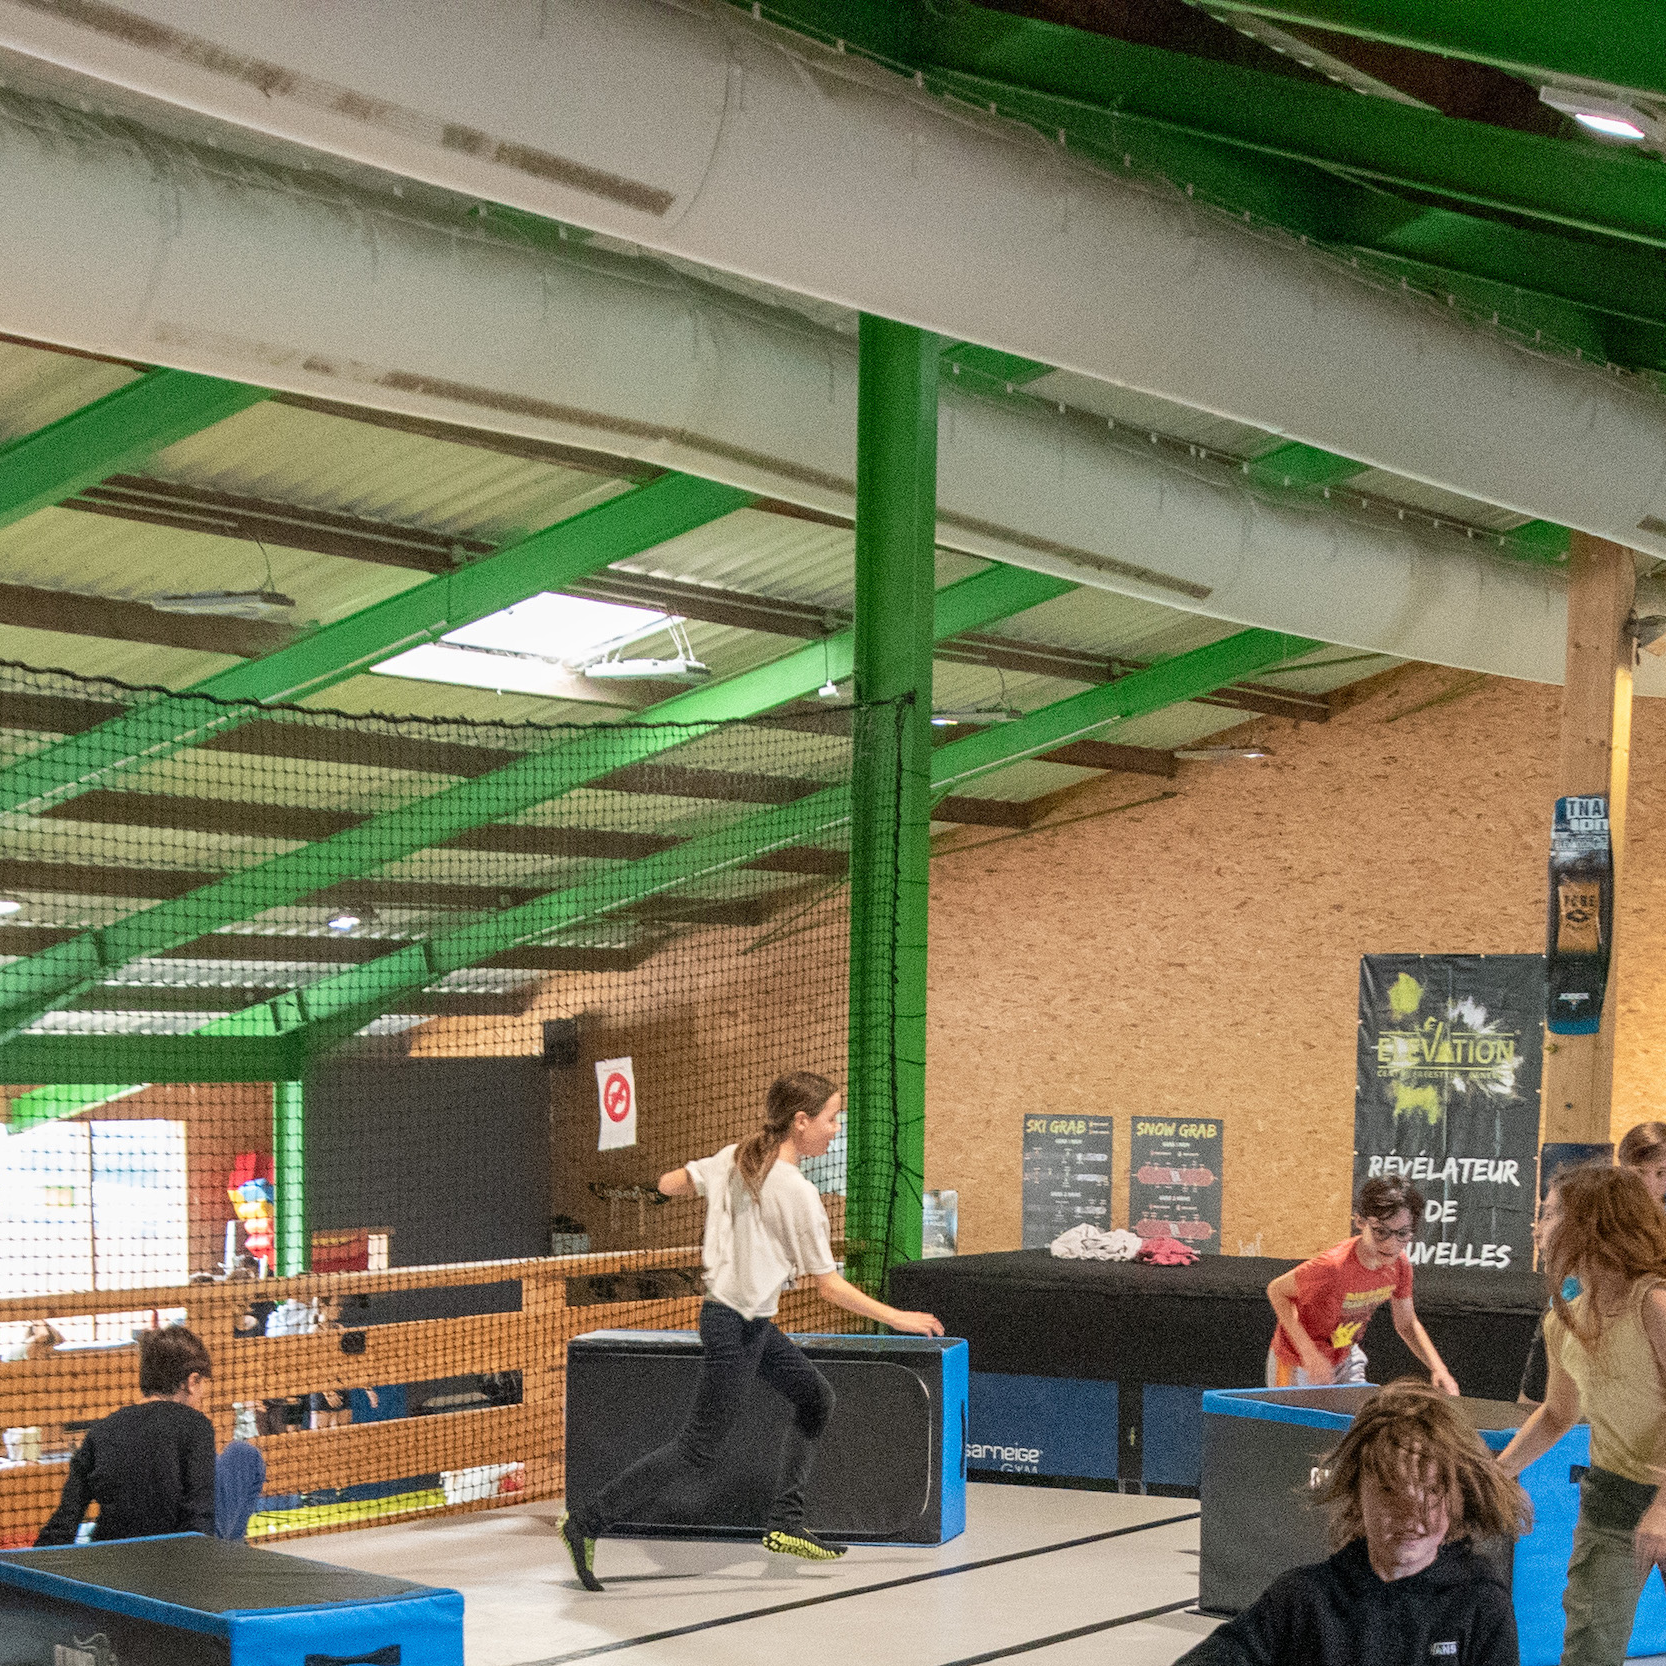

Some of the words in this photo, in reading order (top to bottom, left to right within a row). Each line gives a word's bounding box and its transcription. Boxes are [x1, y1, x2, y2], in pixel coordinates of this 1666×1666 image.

[1026, 1119, 1046, 1134] SKI
[1049, 1120, 1087, 1135] GRAB
[1136, 1122, 1176, 1137] SNOW
[1179, 1123, 1218, 1139] GRAB
[1367, 1149, 1521, 1187] RÉVÉLATEUR
[1424, 1199, 1459, 1223] DE
[1405, 1241, 1513, 1269] UVELLES
